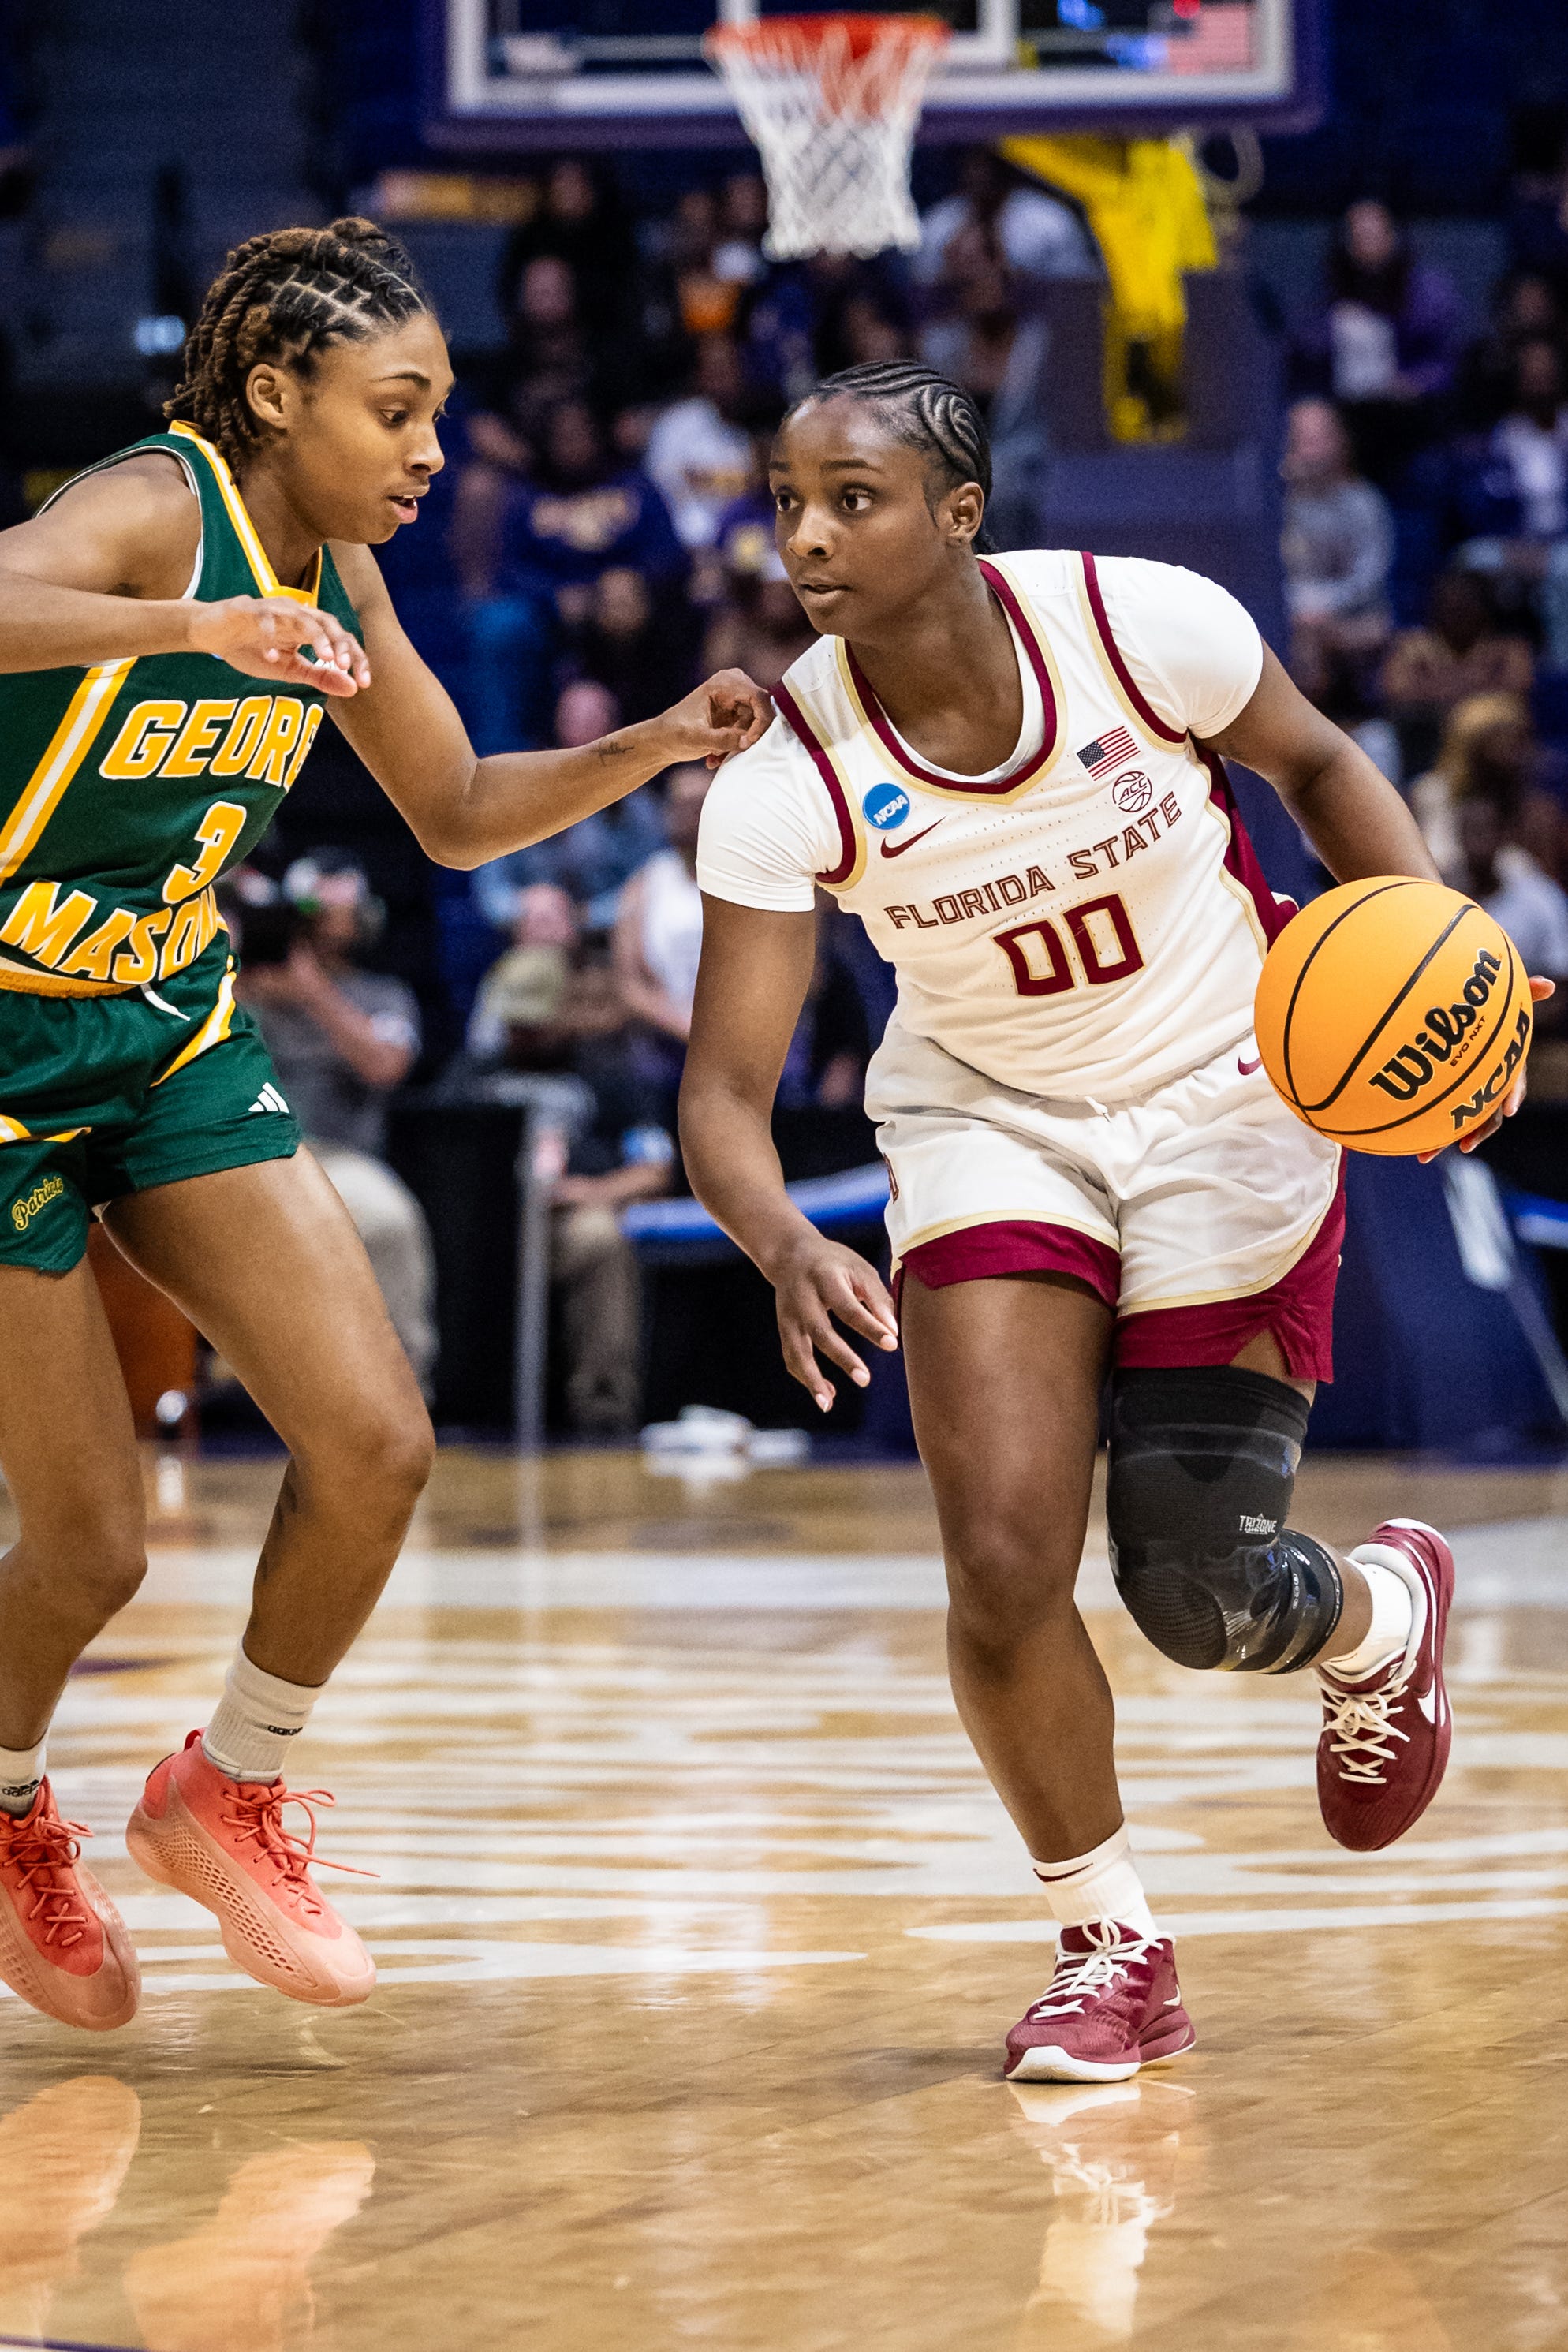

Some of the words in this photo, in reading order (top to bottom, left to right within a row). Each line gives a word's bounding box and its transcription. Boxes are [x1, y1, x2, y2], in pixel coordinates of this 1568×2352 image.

[873, 794, 908, 826] NCAA
[1120, 775, 1148, 801] ACC
[162, 801, 247, 904] 3
[883, 865, 1055, 930] FLORIDA
[1066, 791, 1182, 880] STATE
[0, 881, 218, 984] MASON
[990, 891, 1145, 998] 00
[1368, 947, 1502, 1101] Wilson
[1450, 1042, 1469, 1067] EVO
[1469, 1015, 1486, 1041] NXT
[1450, 1008, 1530, 1131] NCAA
[1239, 1514, 1277, 1535] TRIZONE
